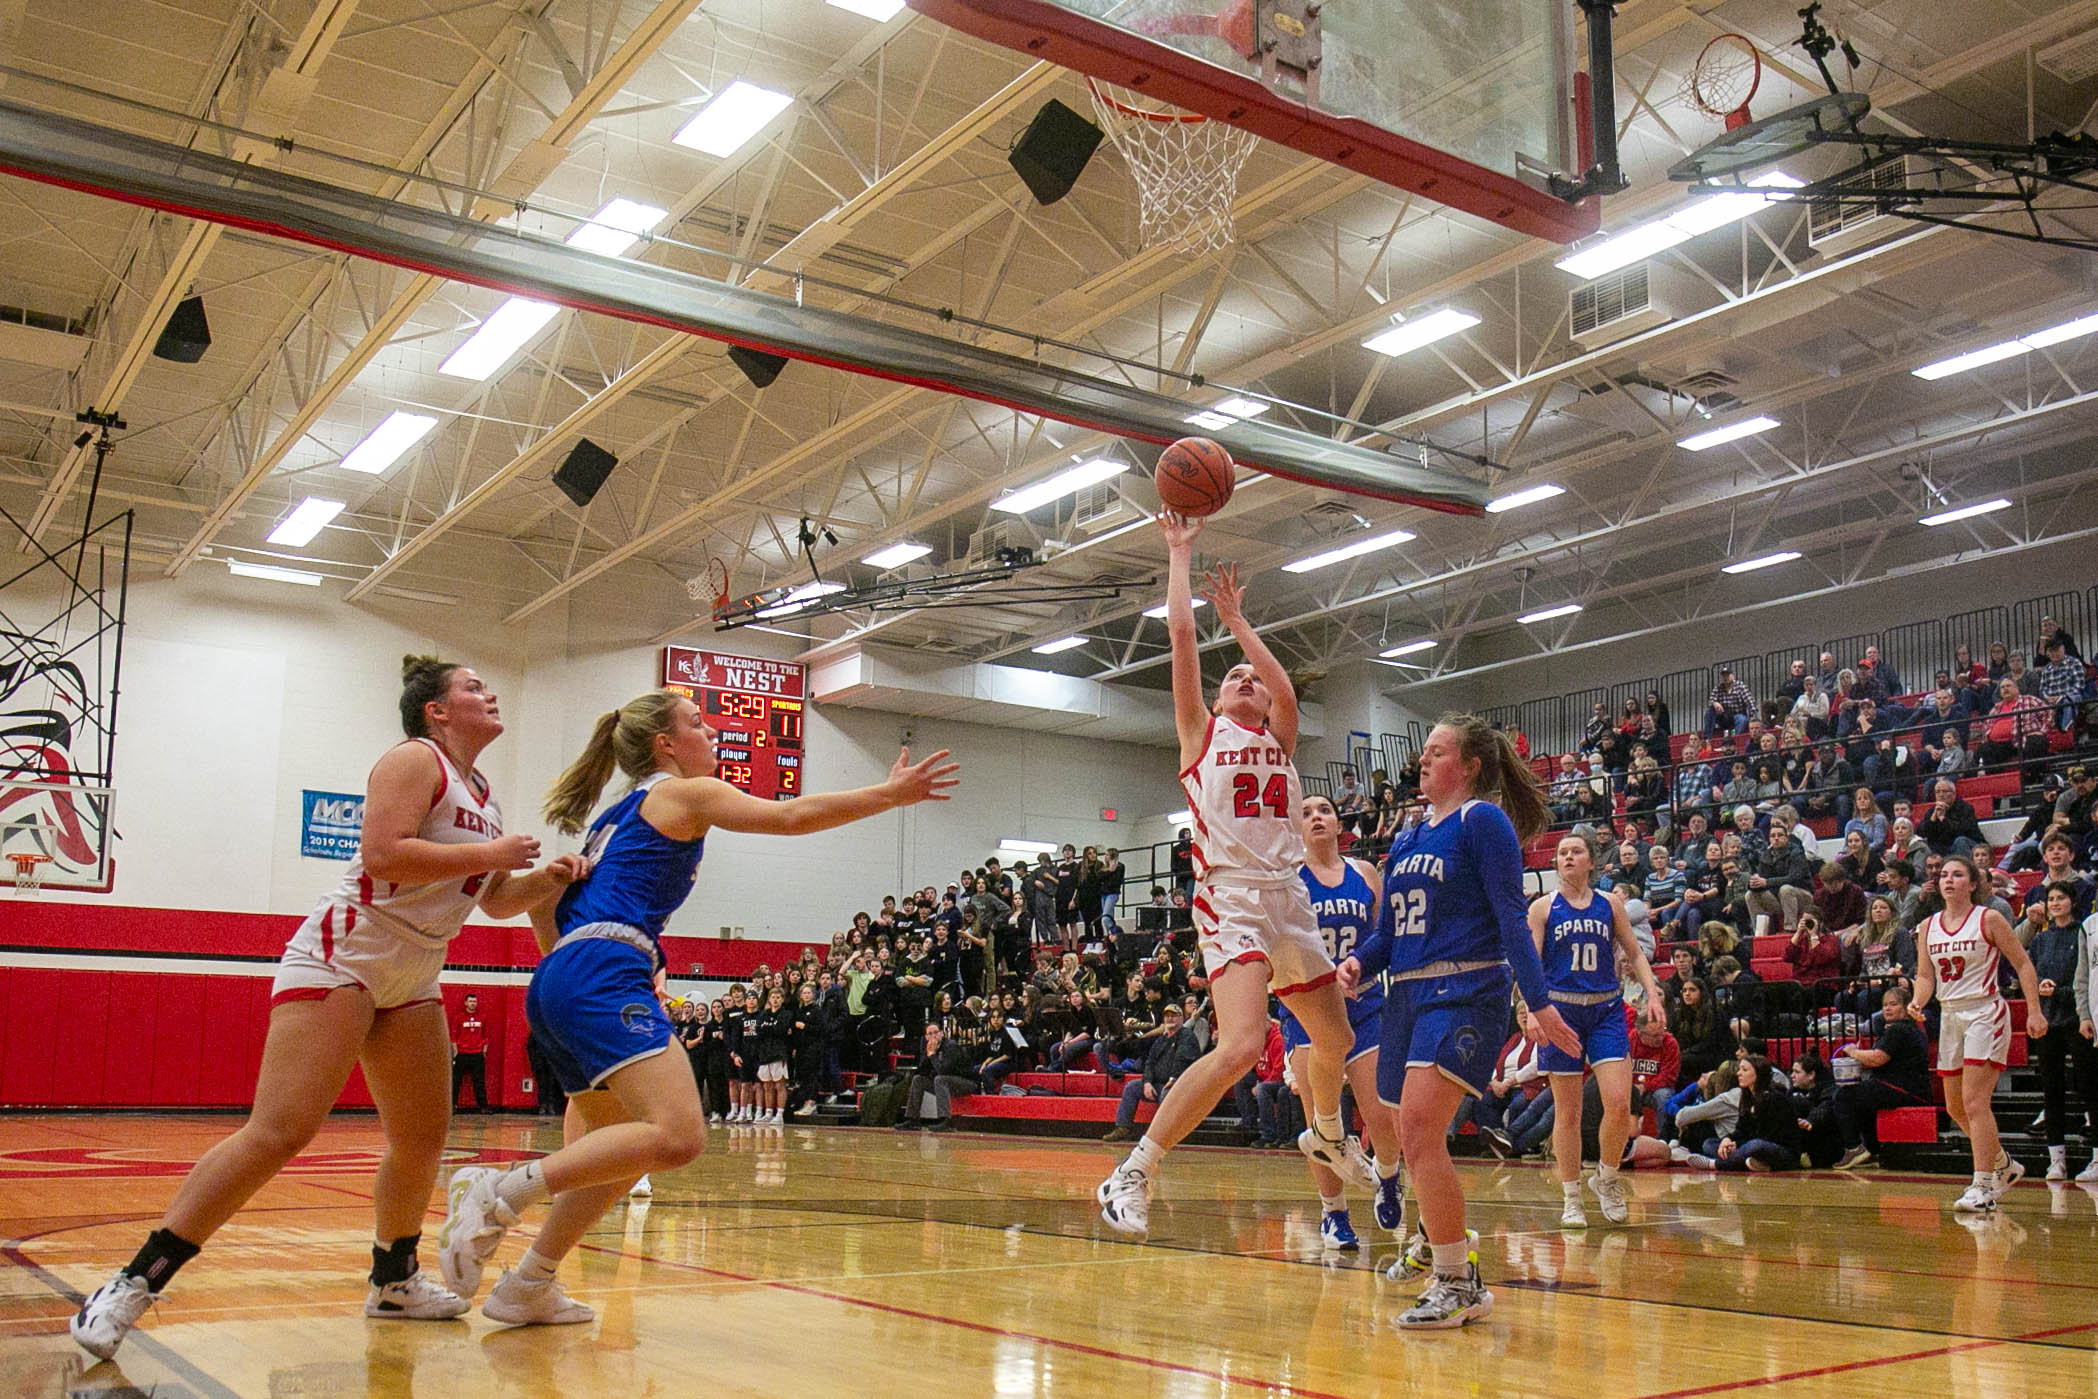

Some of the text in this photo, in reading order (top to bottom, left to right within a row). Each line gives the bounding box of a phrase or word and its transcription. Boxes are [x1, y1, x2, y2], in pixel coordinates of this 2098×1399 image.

[713, 655, 799, 676] WELCOME TO THE
[725, 668, 786, 693] NEST
[720, 693, 765, 720] 5:29
[722, 731, 748, 744] period
[781, 715, 801, 738] 11
[755, 730, 766, 747] 2
[720, 749, 748, 762] player
[777, 755, 798, 767] fouls
[1216, 747, 1261, 766] KENT
[720, 765, 752, 784] 1-32
[783, 771, 795, 789] 2
[1233, 773, 1289, 818] 24
[310, 836, 335, 847] 2019
[1392, 854, 1445, 882] ARTA
[1312, 898, 1368, 922] PARTA
[1390, 888, 1427, 937] 22
[1554, 919, 1610, 942] SPARTA
[1320, 926, 1357, 960] 32
[1952, 940, 1977, 952] CITY
[1570, 943, 1598, 971] 10
